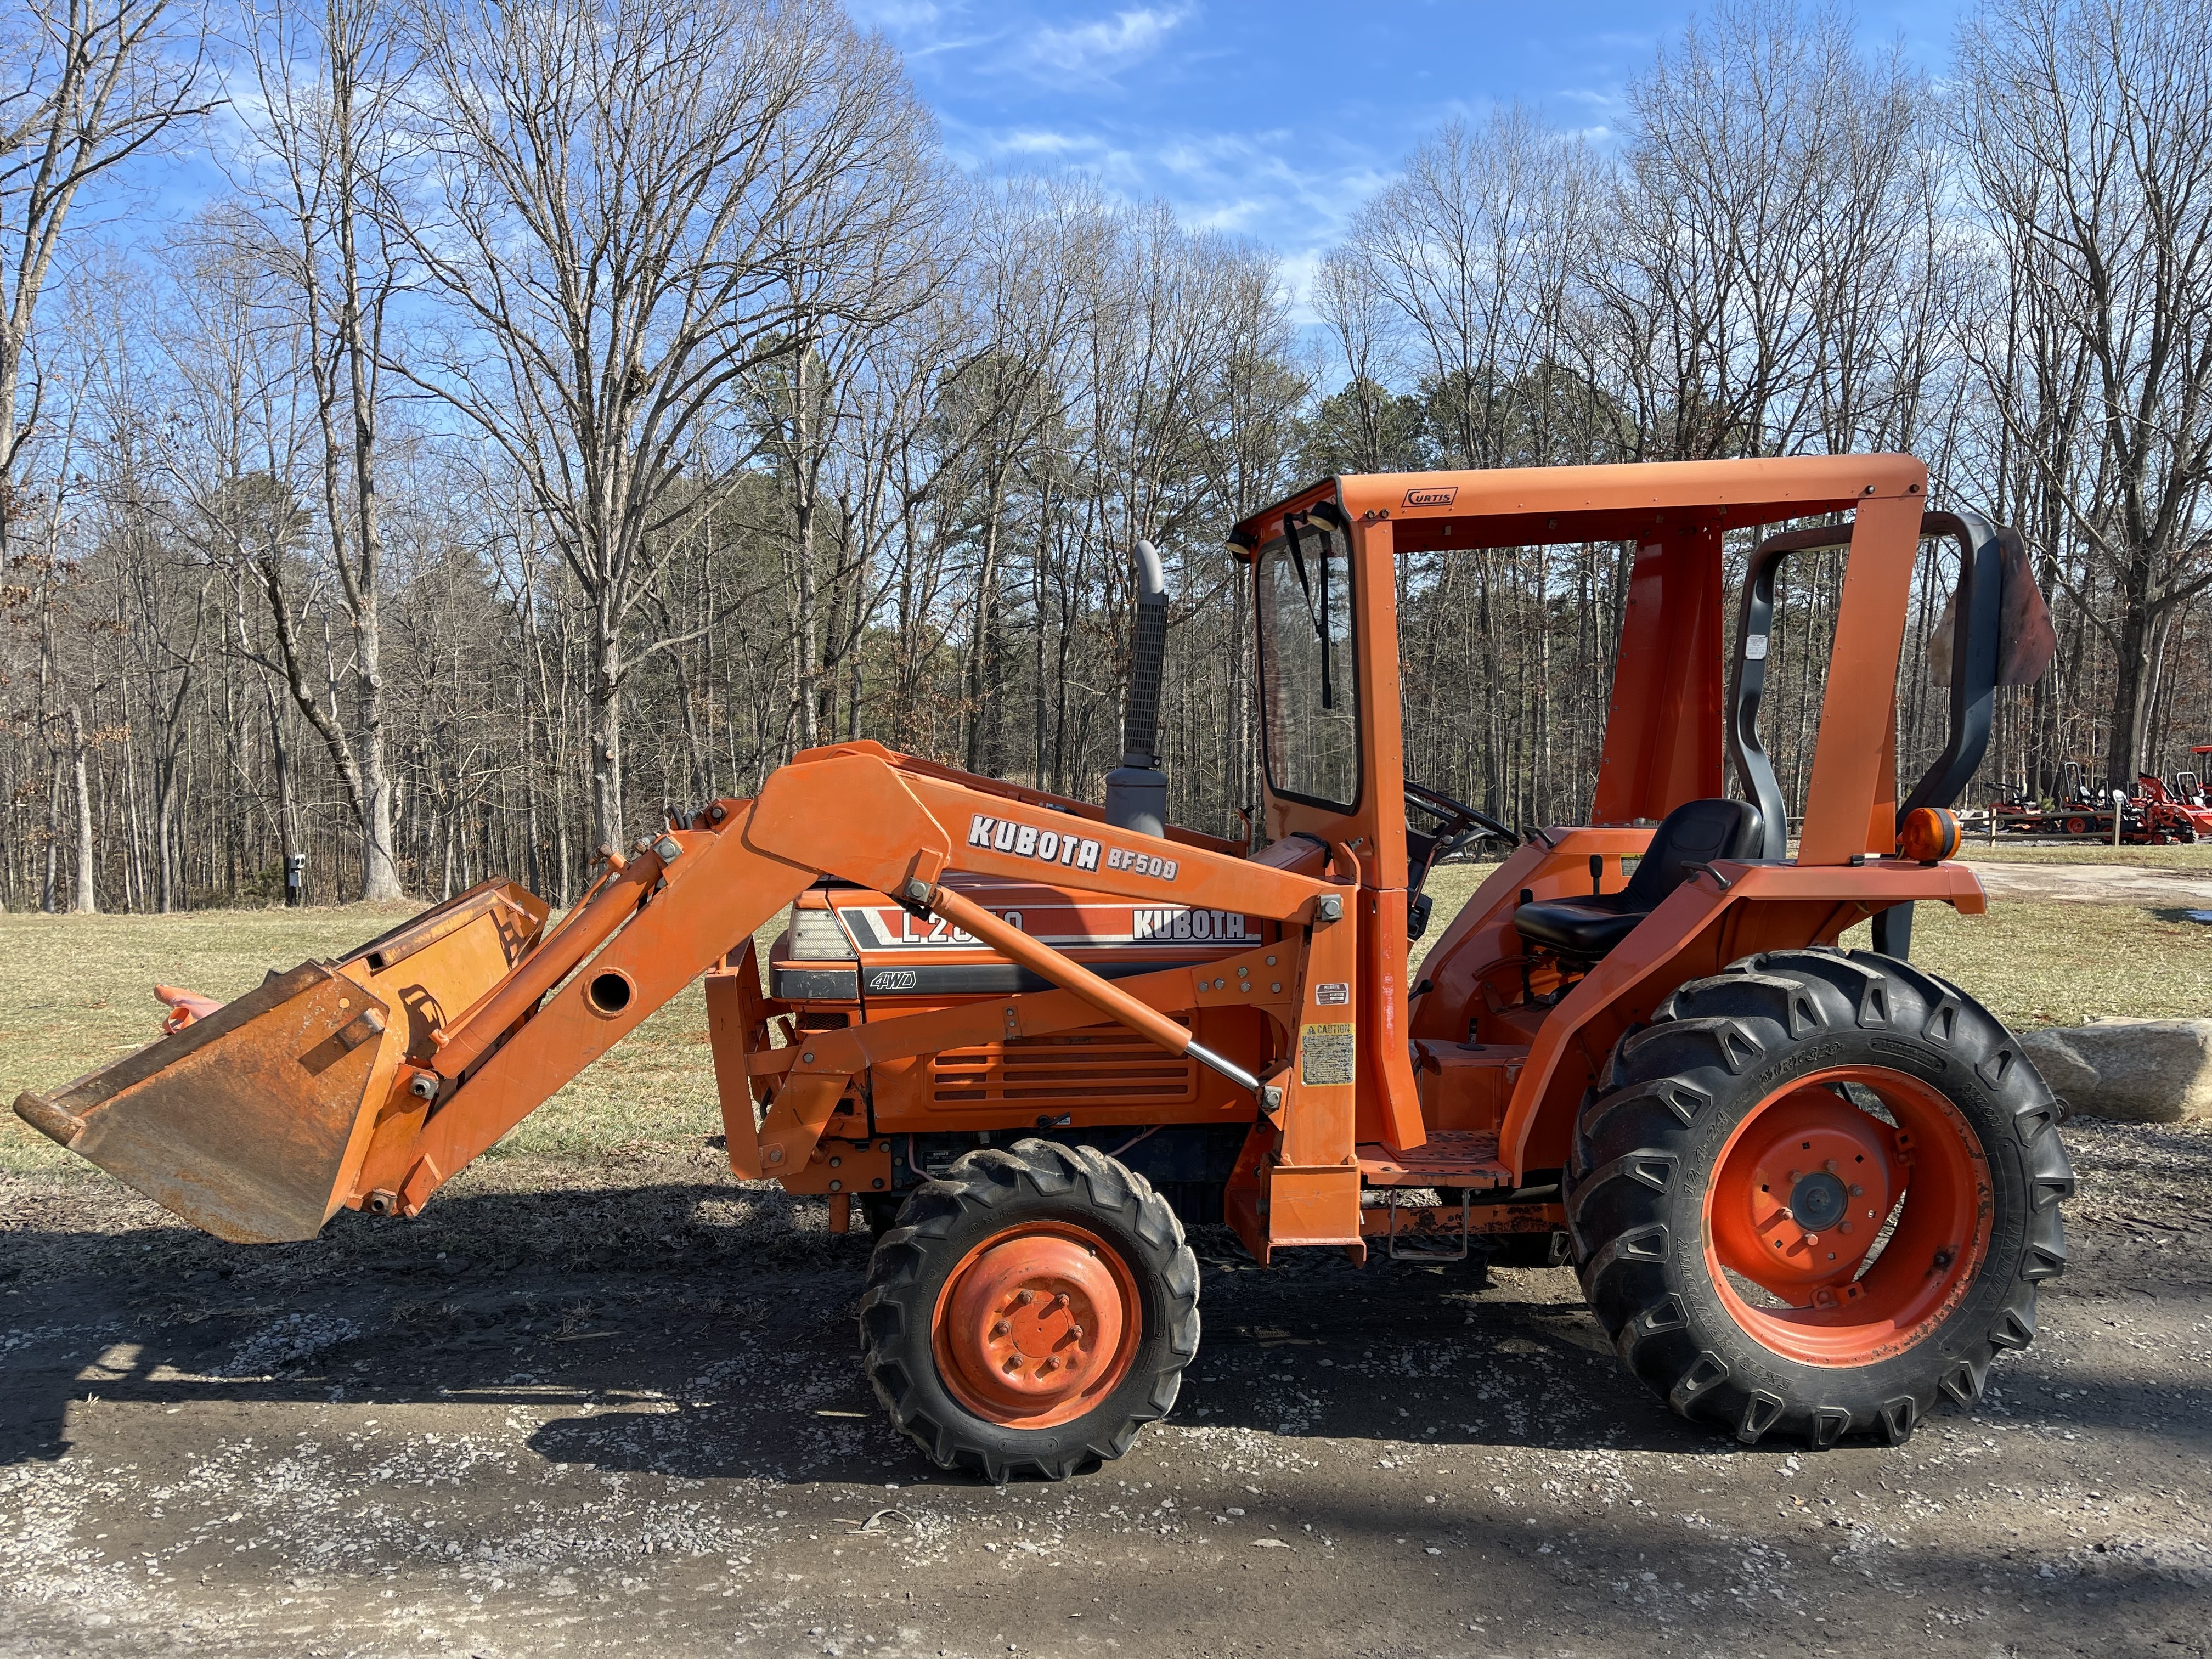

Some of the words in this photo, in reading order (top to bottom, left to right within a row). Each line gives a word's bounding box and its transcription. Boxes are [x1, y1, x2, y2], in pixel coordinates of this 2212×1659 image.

[968, 815, 1102, 872] KUBOTA
[1107, 847, 1178, 881] BF500
[1132, 909, 1246, 940] KUBOTA
[870, 970, 916, 990] 4WD
[1317, 1024, 1350, 1034] CAUTION
[1683, 1108, 1728, 1197] 12.4-24
[910, 1208, 1010, 1343] BRIDGESTONE
[1677, 1237, 1699, 1292] DUTY
[1689, 1294, 1735, 1352] HEAVY
[1729, 1347, 1795, 1391] EXTRA
